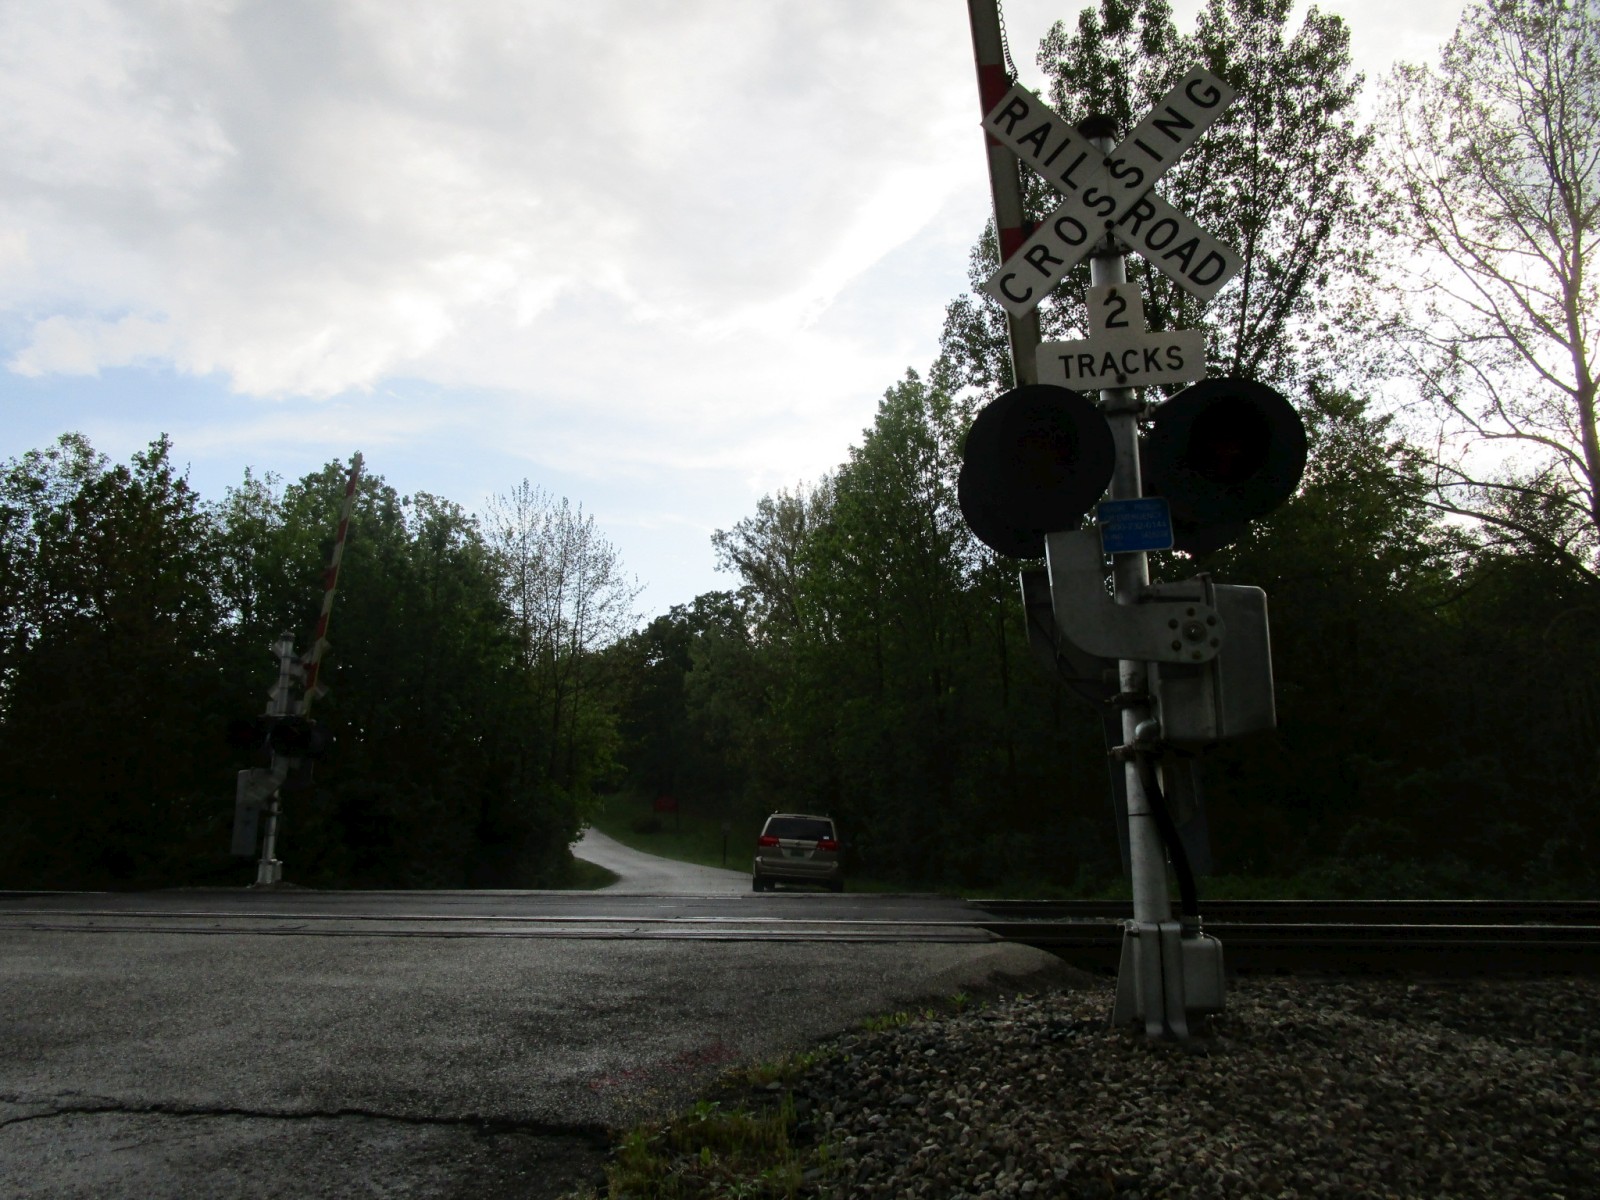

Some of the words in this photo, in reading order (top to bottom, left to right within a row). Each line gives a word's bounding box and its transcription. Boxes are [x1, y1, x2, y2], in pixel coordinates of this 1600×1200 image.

[993, 95, 1088, 190] RAIL
[1118, 199, 1227, 287] ROAD
[999, 78, 1222, 304] CROSSING
[1058, 345, 1185, 379] TRACKS
[1103, 294, 1129, 328] 2
